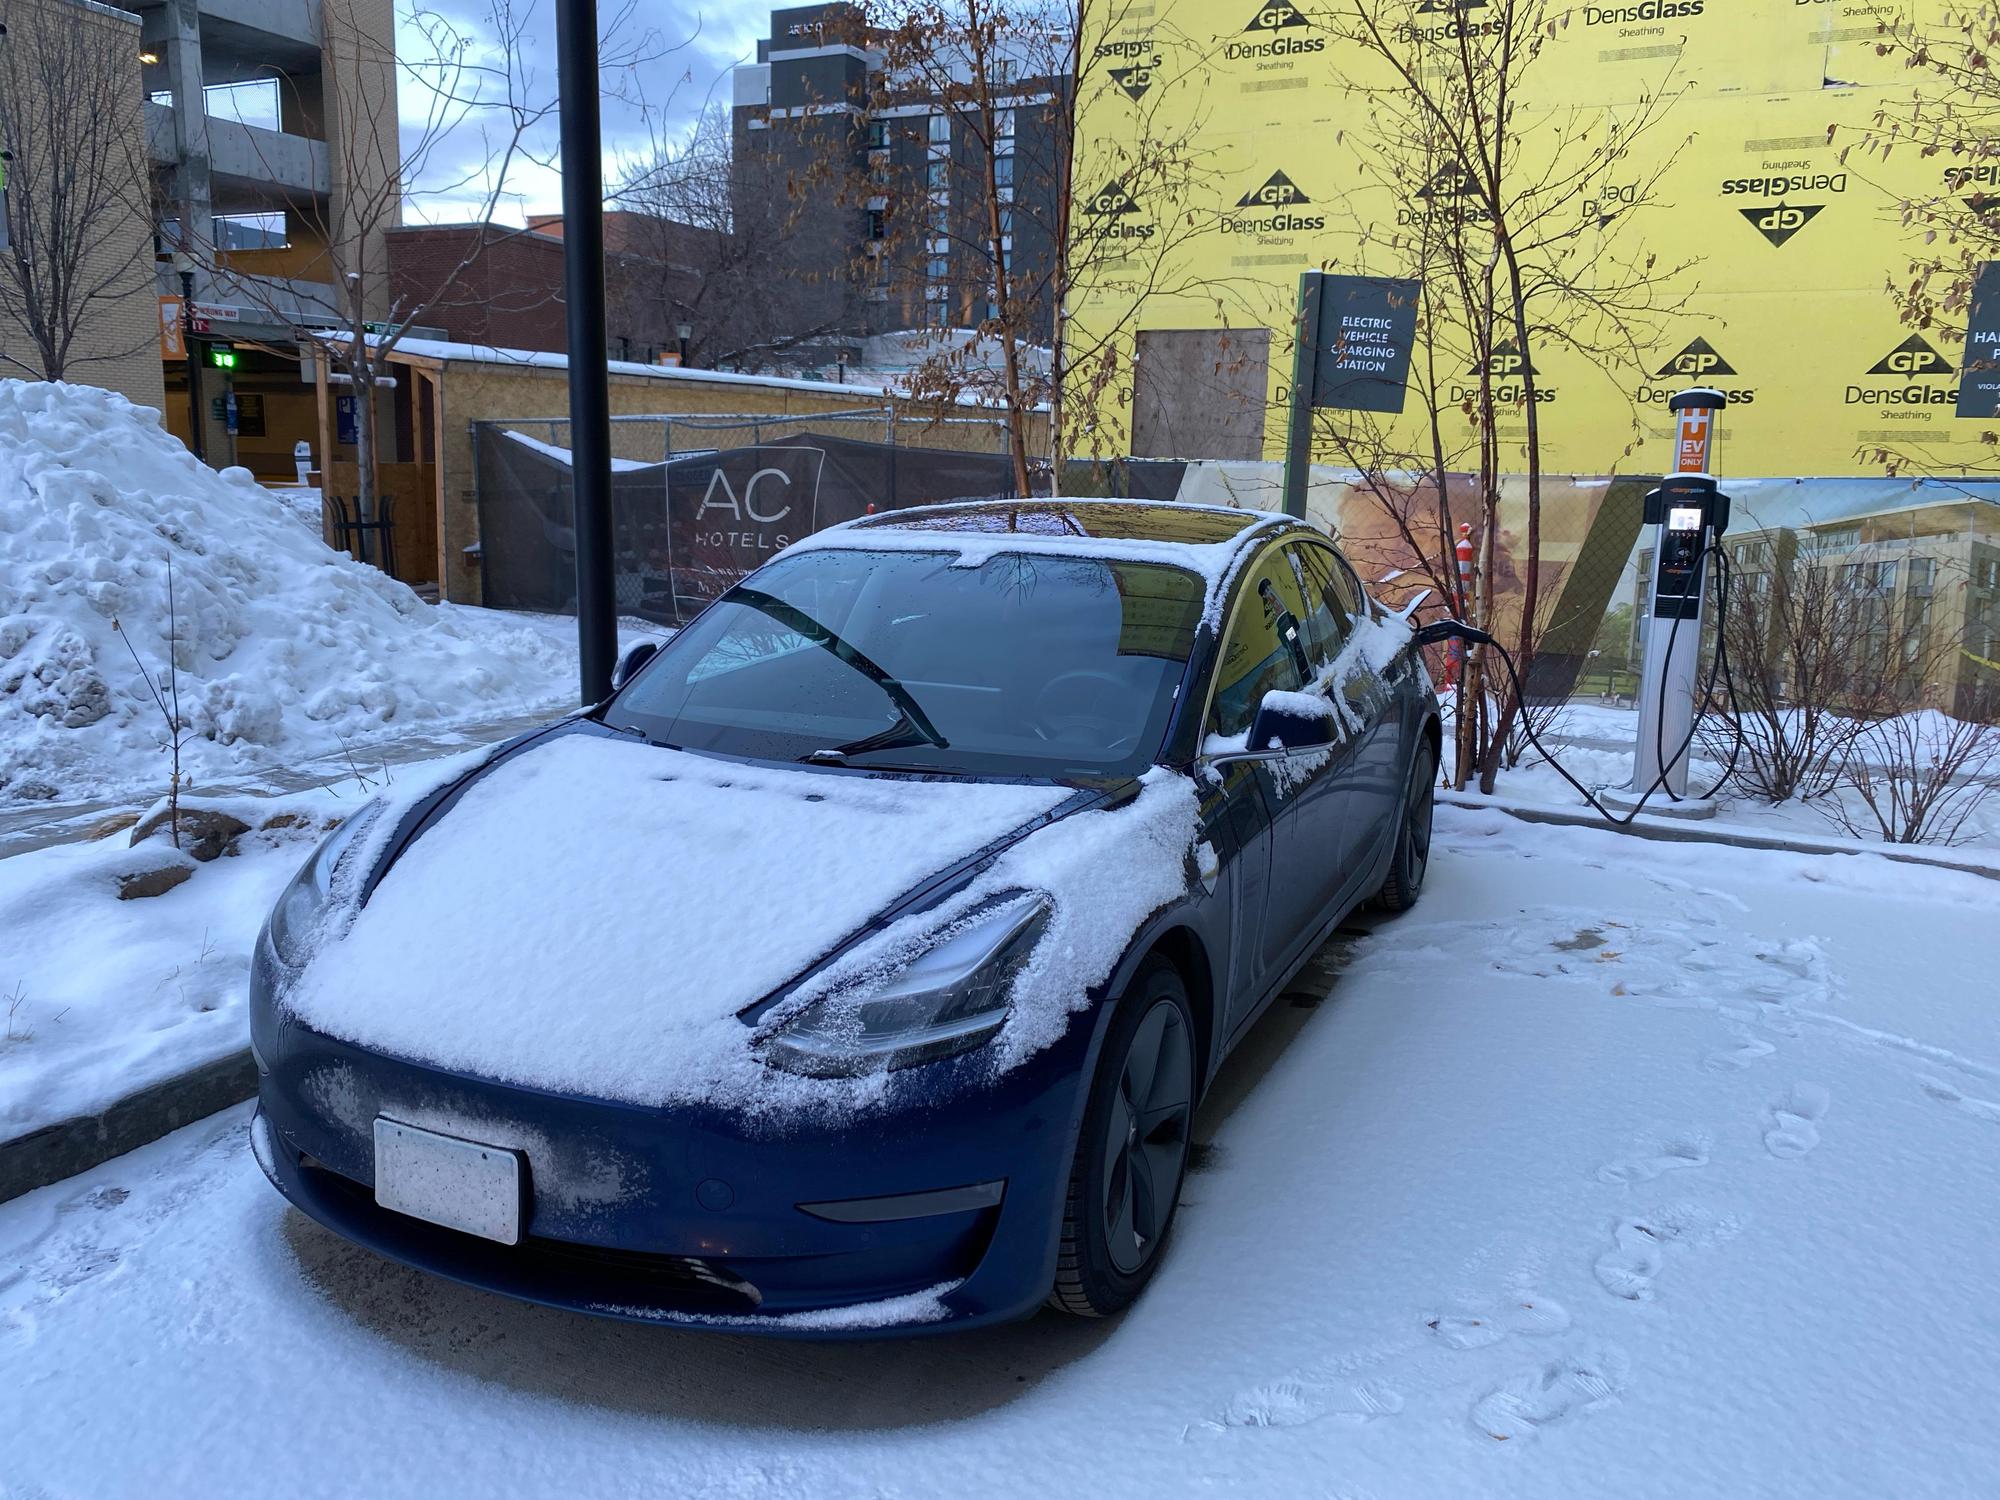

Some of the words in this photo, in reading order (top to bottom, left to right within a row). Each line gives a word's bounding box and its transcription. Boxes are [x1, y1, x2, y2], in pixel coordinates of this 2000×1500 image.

[1258, 7, 1295, 28] GP
[1586, 0, 1704, 26] DensGlass
[1843, 5, 1895, 18] Sheathing
[1400, 19, 1504, 44] DensGass
[1618, 26, 1665, 38] Sheathing
[1256, 61, 1294, 71] Sheathing
[1762, 160, 1811, 171] Sheathing
[1260, 185, 1295, 203] GP
[1722, 173, 1847, 197] DensGlass
[1759, 209, 1805, 229] GP
[180, 318, 204, 331] EIT
[1342, 316, 1392, 329] ELECTRIC
[1344, 331, 1389, 343] VEHICLE
[1974, 331, 2000, 343] HA
[1490, 355, 1523, 373] GP
[1675, 354, 1718, 373] GP
[1888, 351, 1936, 372] GP
[1845, 385, 1959, 404] DensGlas
[1880, 409, 1932, 421] Sheathing
[1682, 440, 1704, 453] EV
[1681, 458, 1702, 466] ONLY
[696, 468, 791, 522] AC
[696, 532, 789, 550] HOTELS
